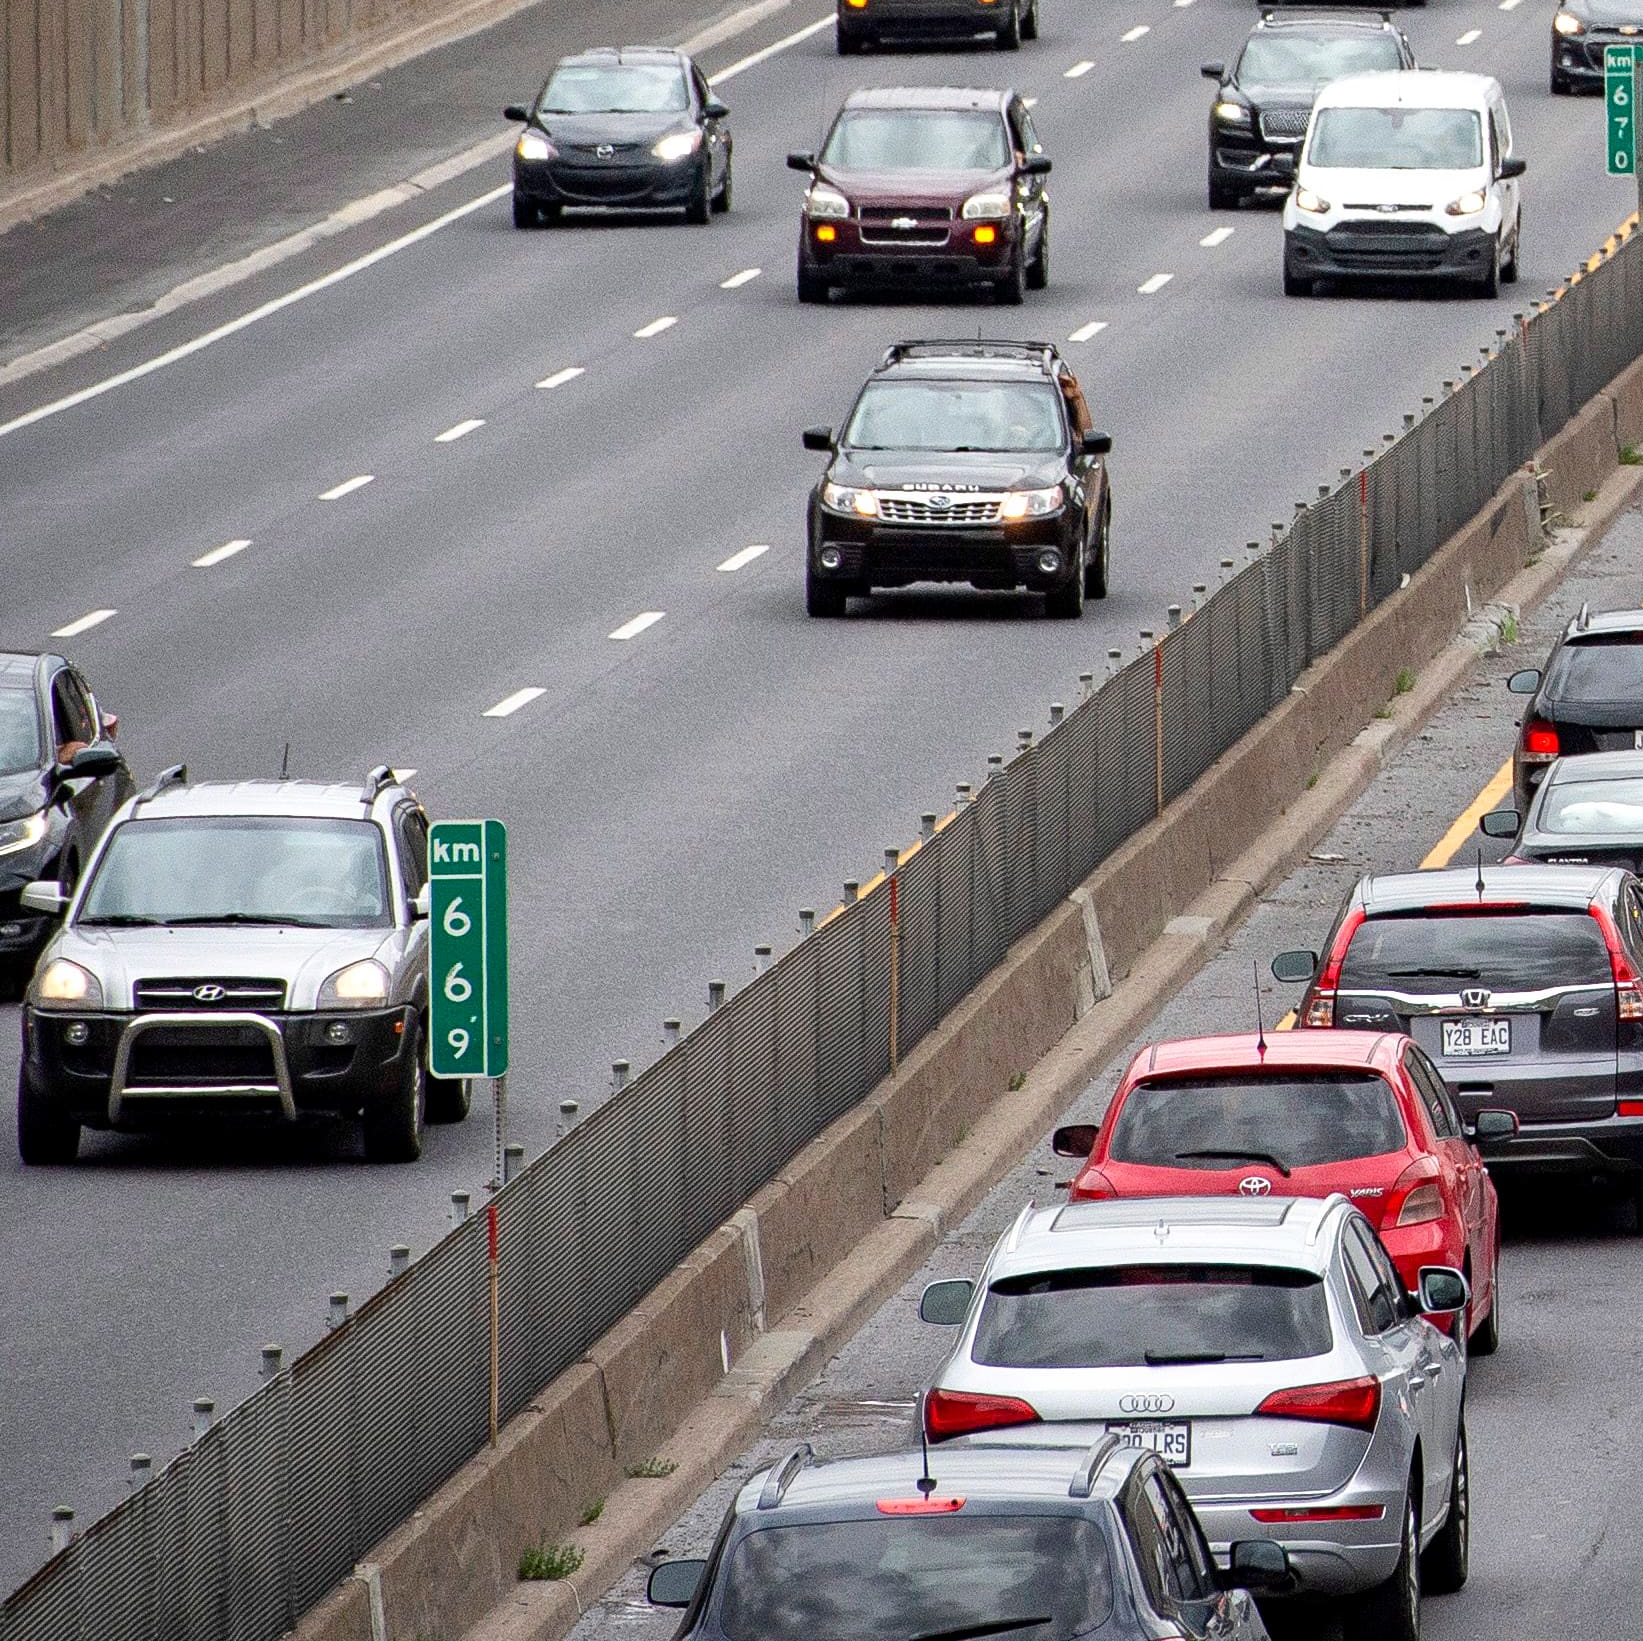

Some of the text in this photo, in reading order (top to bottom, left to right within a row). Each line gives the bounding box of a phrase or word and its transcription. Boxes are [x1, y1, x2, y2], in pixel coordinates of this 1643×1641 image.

[1607, 53, 1631, 68] km
[433, 837, 481, 864] km
[1445, 1027, 1507, 1047] Y28 EAC
[1154, 1433, 1186, 1454] LRS
